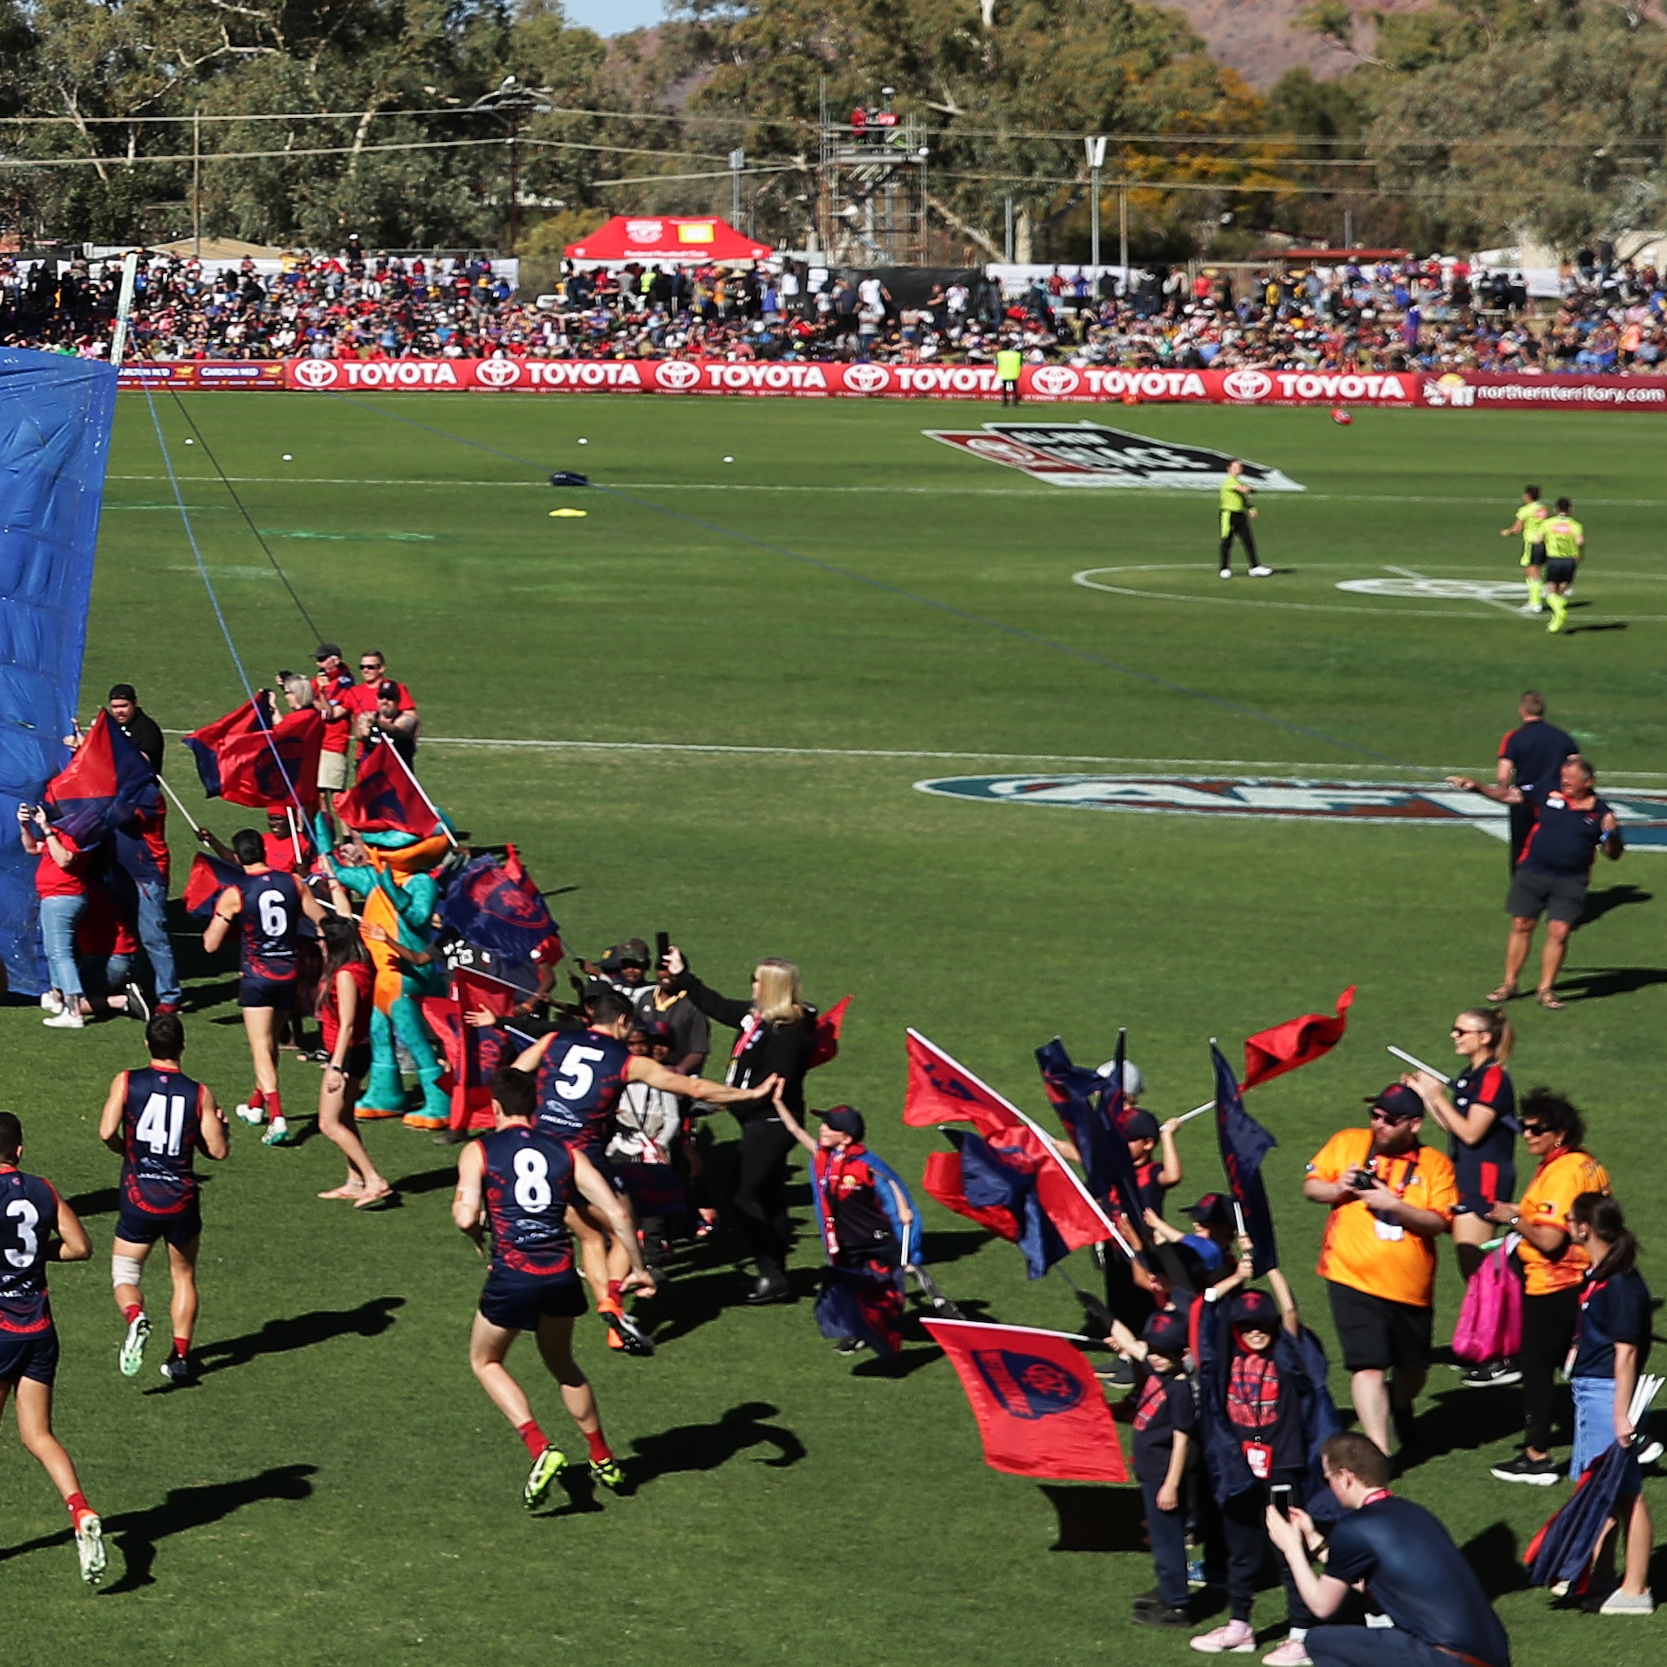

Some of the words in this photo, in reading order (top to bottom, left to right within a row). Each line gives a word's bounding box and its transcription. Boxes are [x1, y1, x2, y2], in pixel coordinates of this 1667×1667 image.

[343, 362, 458, 385] TOYOTA
[525, 362, 641, 385] TOYOTA
[704, 365, 827, 387] TOYOTA
[894, 368, 1004, 391] TOYOTA
[1084, 370, 1206, 396] TOYOTA
[1277, 374, 1406, 399] TOYOTA
[1477, 384, 1665, 404] northernterritory.com
[258, 888, 288, 937] 6
[554, 1044, 605, 1101] 5
[136, 1092, 186, 1157] 41
[513, 1146, 552, 1214] 8
[3, 1198, 40, 1268] 3
